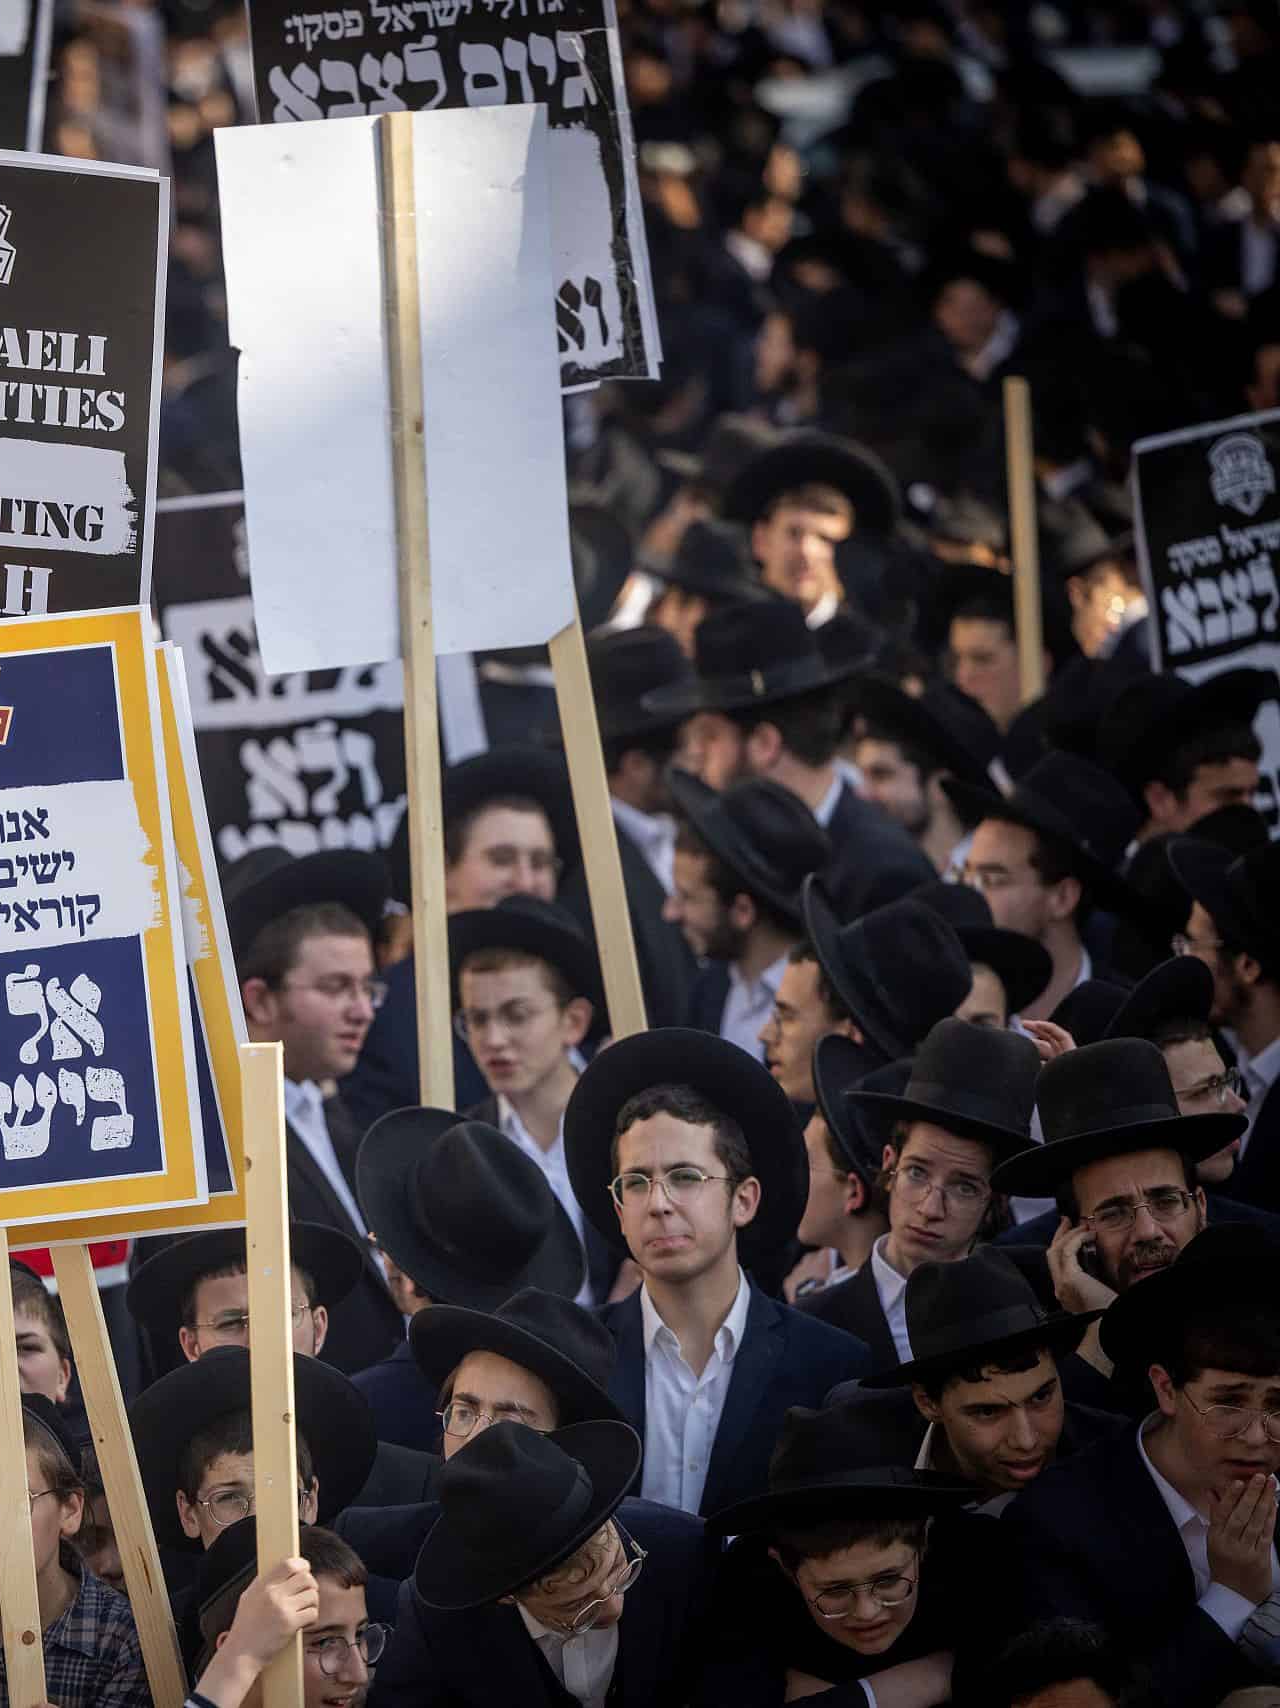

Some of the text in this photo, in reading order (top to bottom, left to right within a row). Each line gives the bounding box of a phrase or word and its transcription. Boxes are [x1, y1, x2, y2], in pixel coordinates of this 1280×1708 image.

[284, 9, 365, 51] פסקו:
[269, 30, 597, 123] גיוס לצבא
[554, 275, 608, 352] וא
[5, 964, 105, 1065] אל
